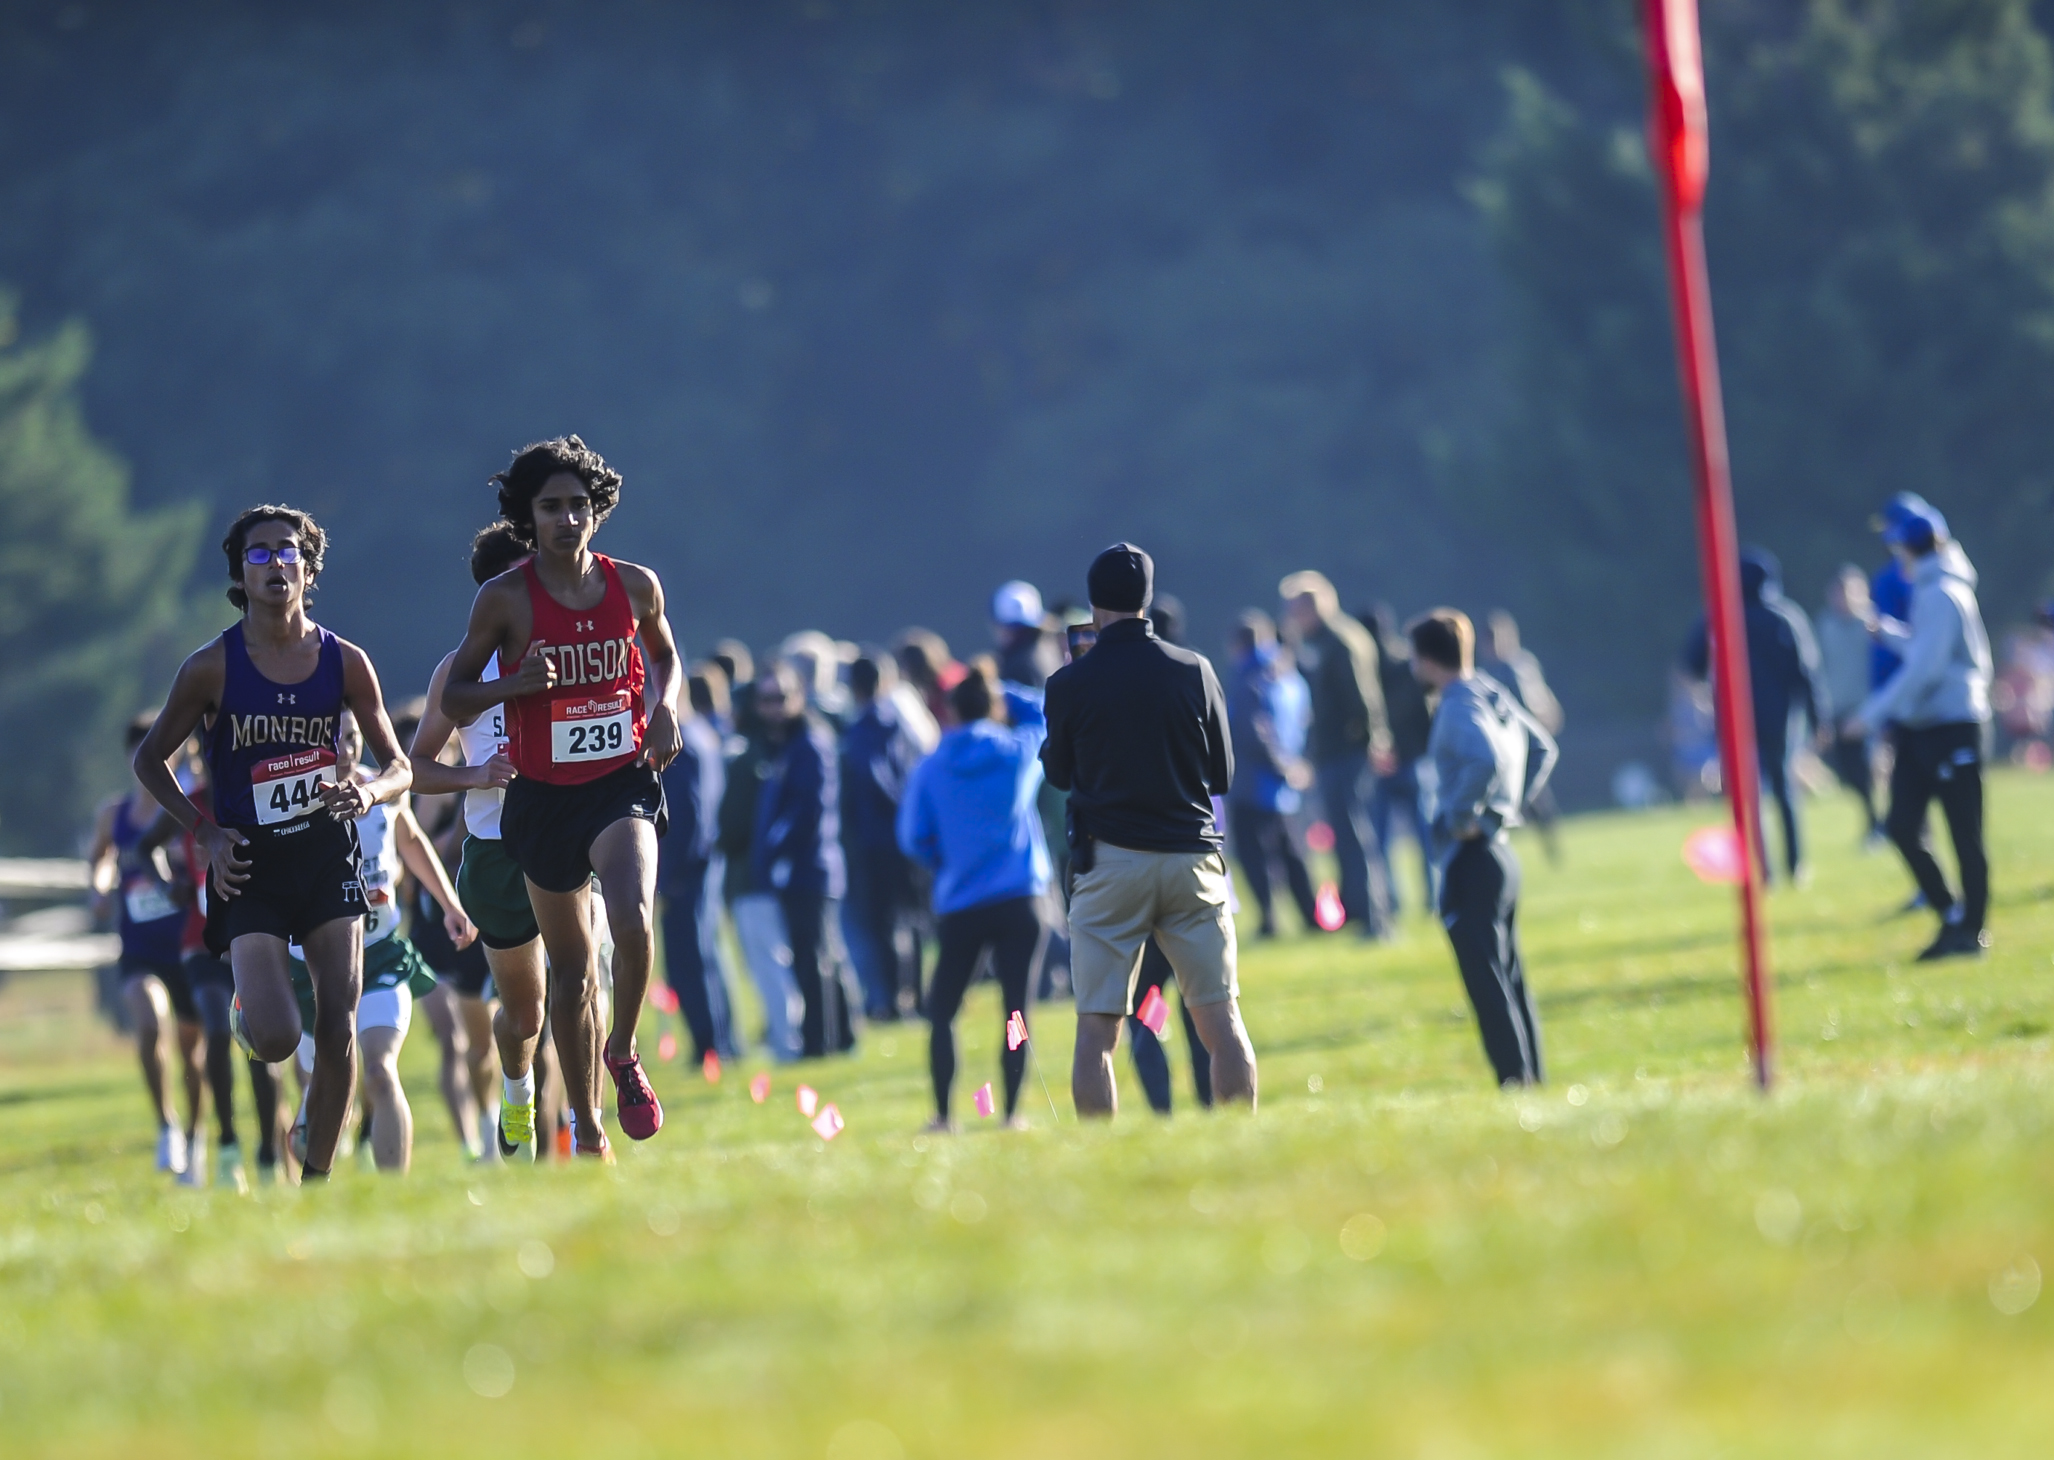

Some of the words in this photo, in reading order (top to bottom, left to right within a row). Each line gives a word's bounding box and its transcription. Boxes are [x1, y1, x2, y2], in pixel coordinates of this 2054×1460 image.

[566, 705, 588, 715] RACE
[597, 699, 623, 712] RESULT
[230, 714, 334, 751] MONROE
[568, 722, 622, 754] 239
[270, 773, 323, 813] 444
